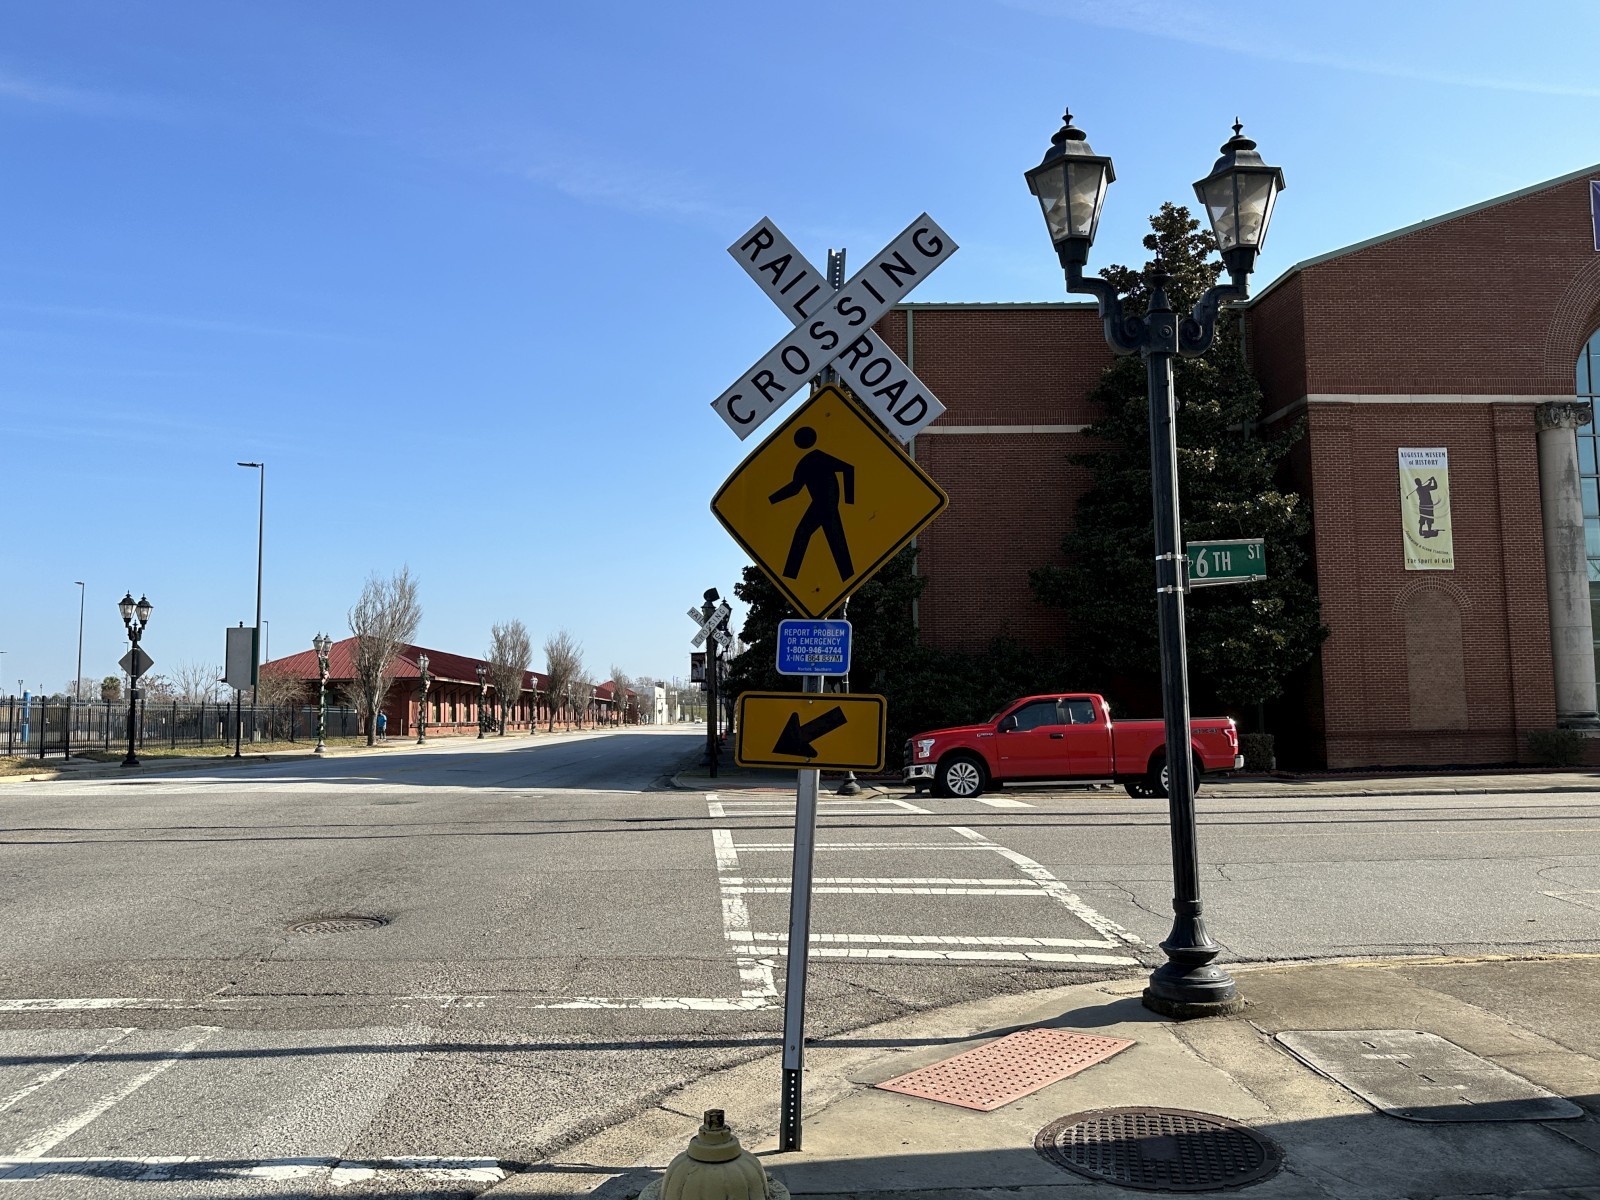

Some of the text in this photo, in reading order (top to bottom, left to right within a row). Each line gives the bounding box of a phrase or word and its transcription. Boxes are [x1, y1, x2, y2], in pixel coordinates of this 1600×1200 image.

[726, 227, 944, 425] CROSSING
[740, 226, 929, 427] RAIL ROAD
[1196, 544, 1260, 577] 6TH ST
[690, 610, 728, 645] RAIL ROAD
[694, 608, 726, 644] CROSSING
[786, 646, 842, 654] 1-800-946-4744
[786, 654, 805, 662] X-ING
